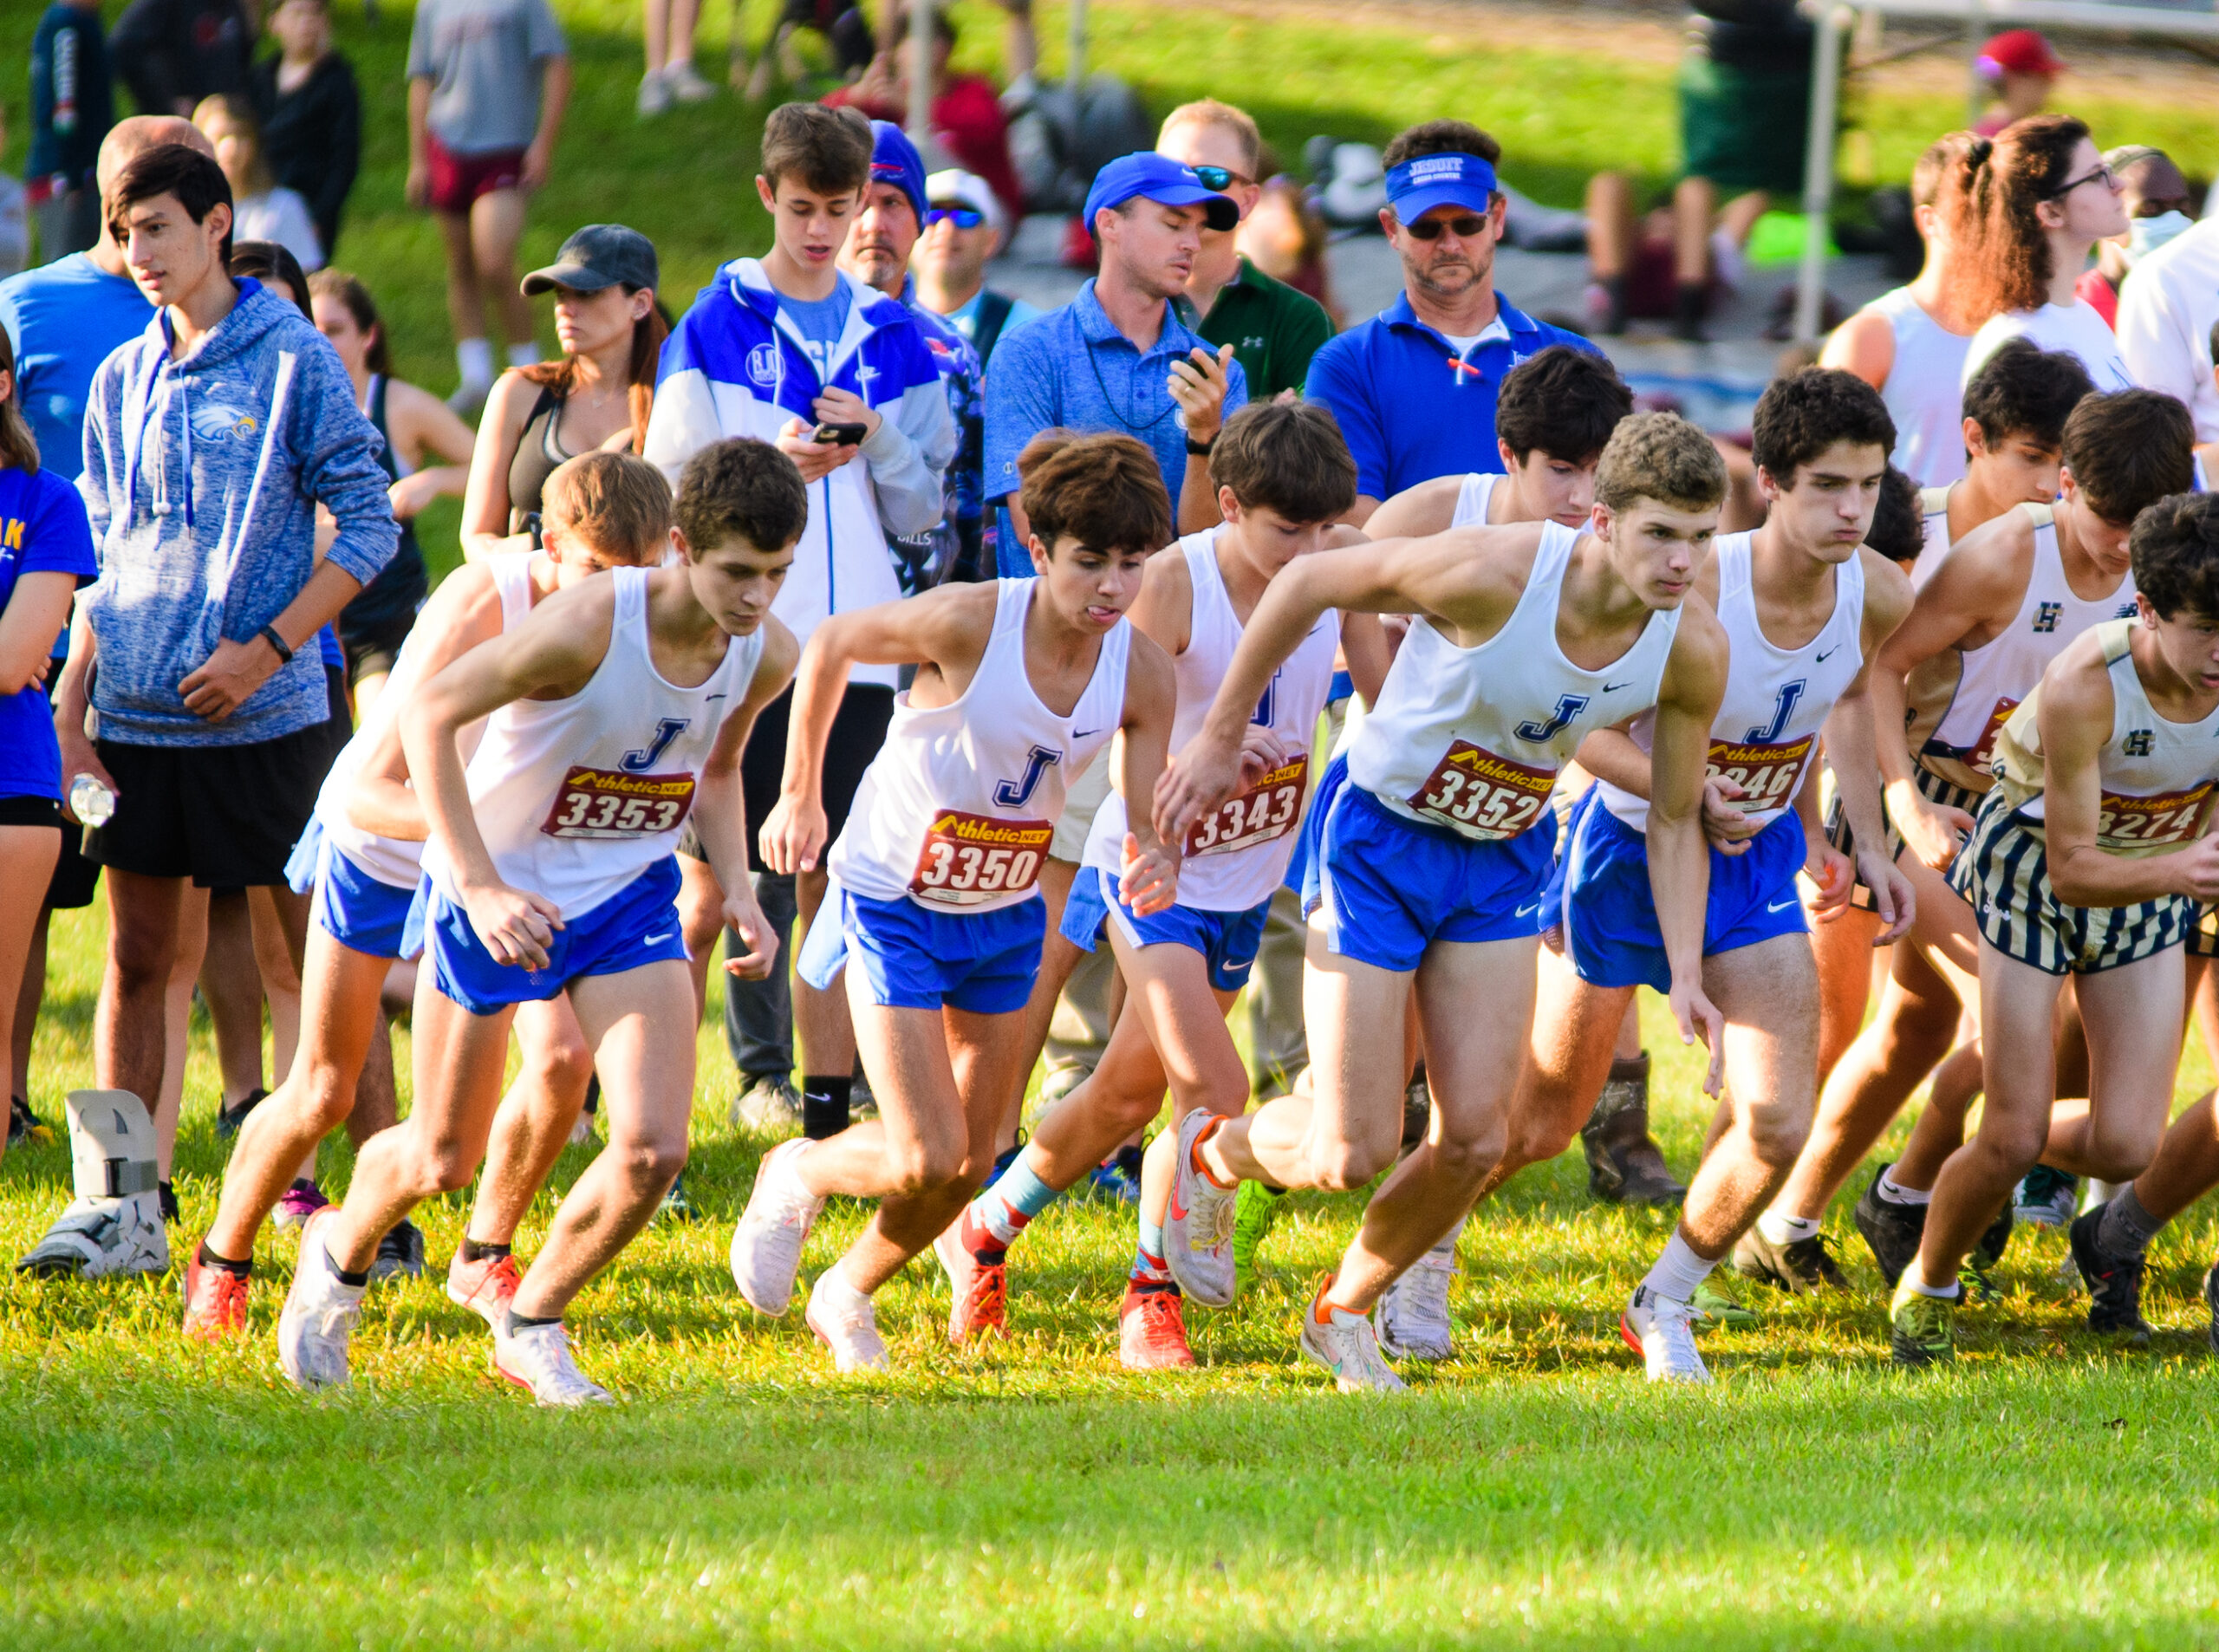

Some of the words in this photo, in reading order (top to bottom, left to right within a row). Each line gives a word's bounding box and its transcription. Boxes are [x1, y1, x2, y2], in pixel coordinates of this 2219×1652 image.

[1513, 693, 1590, 744] J
[1741, 679, 1806, 745] J
[618, 718, 691, 772] J
[992, 745, 1063, 809] J
[1426, 771, 1539, 829] 3352
[557, 793, 679, 830] 3353
[929, 815, 1020, 842] Athletic
[1194, 786, 1297, 849] 3343
[921, 842, 1038, 889] 3350
